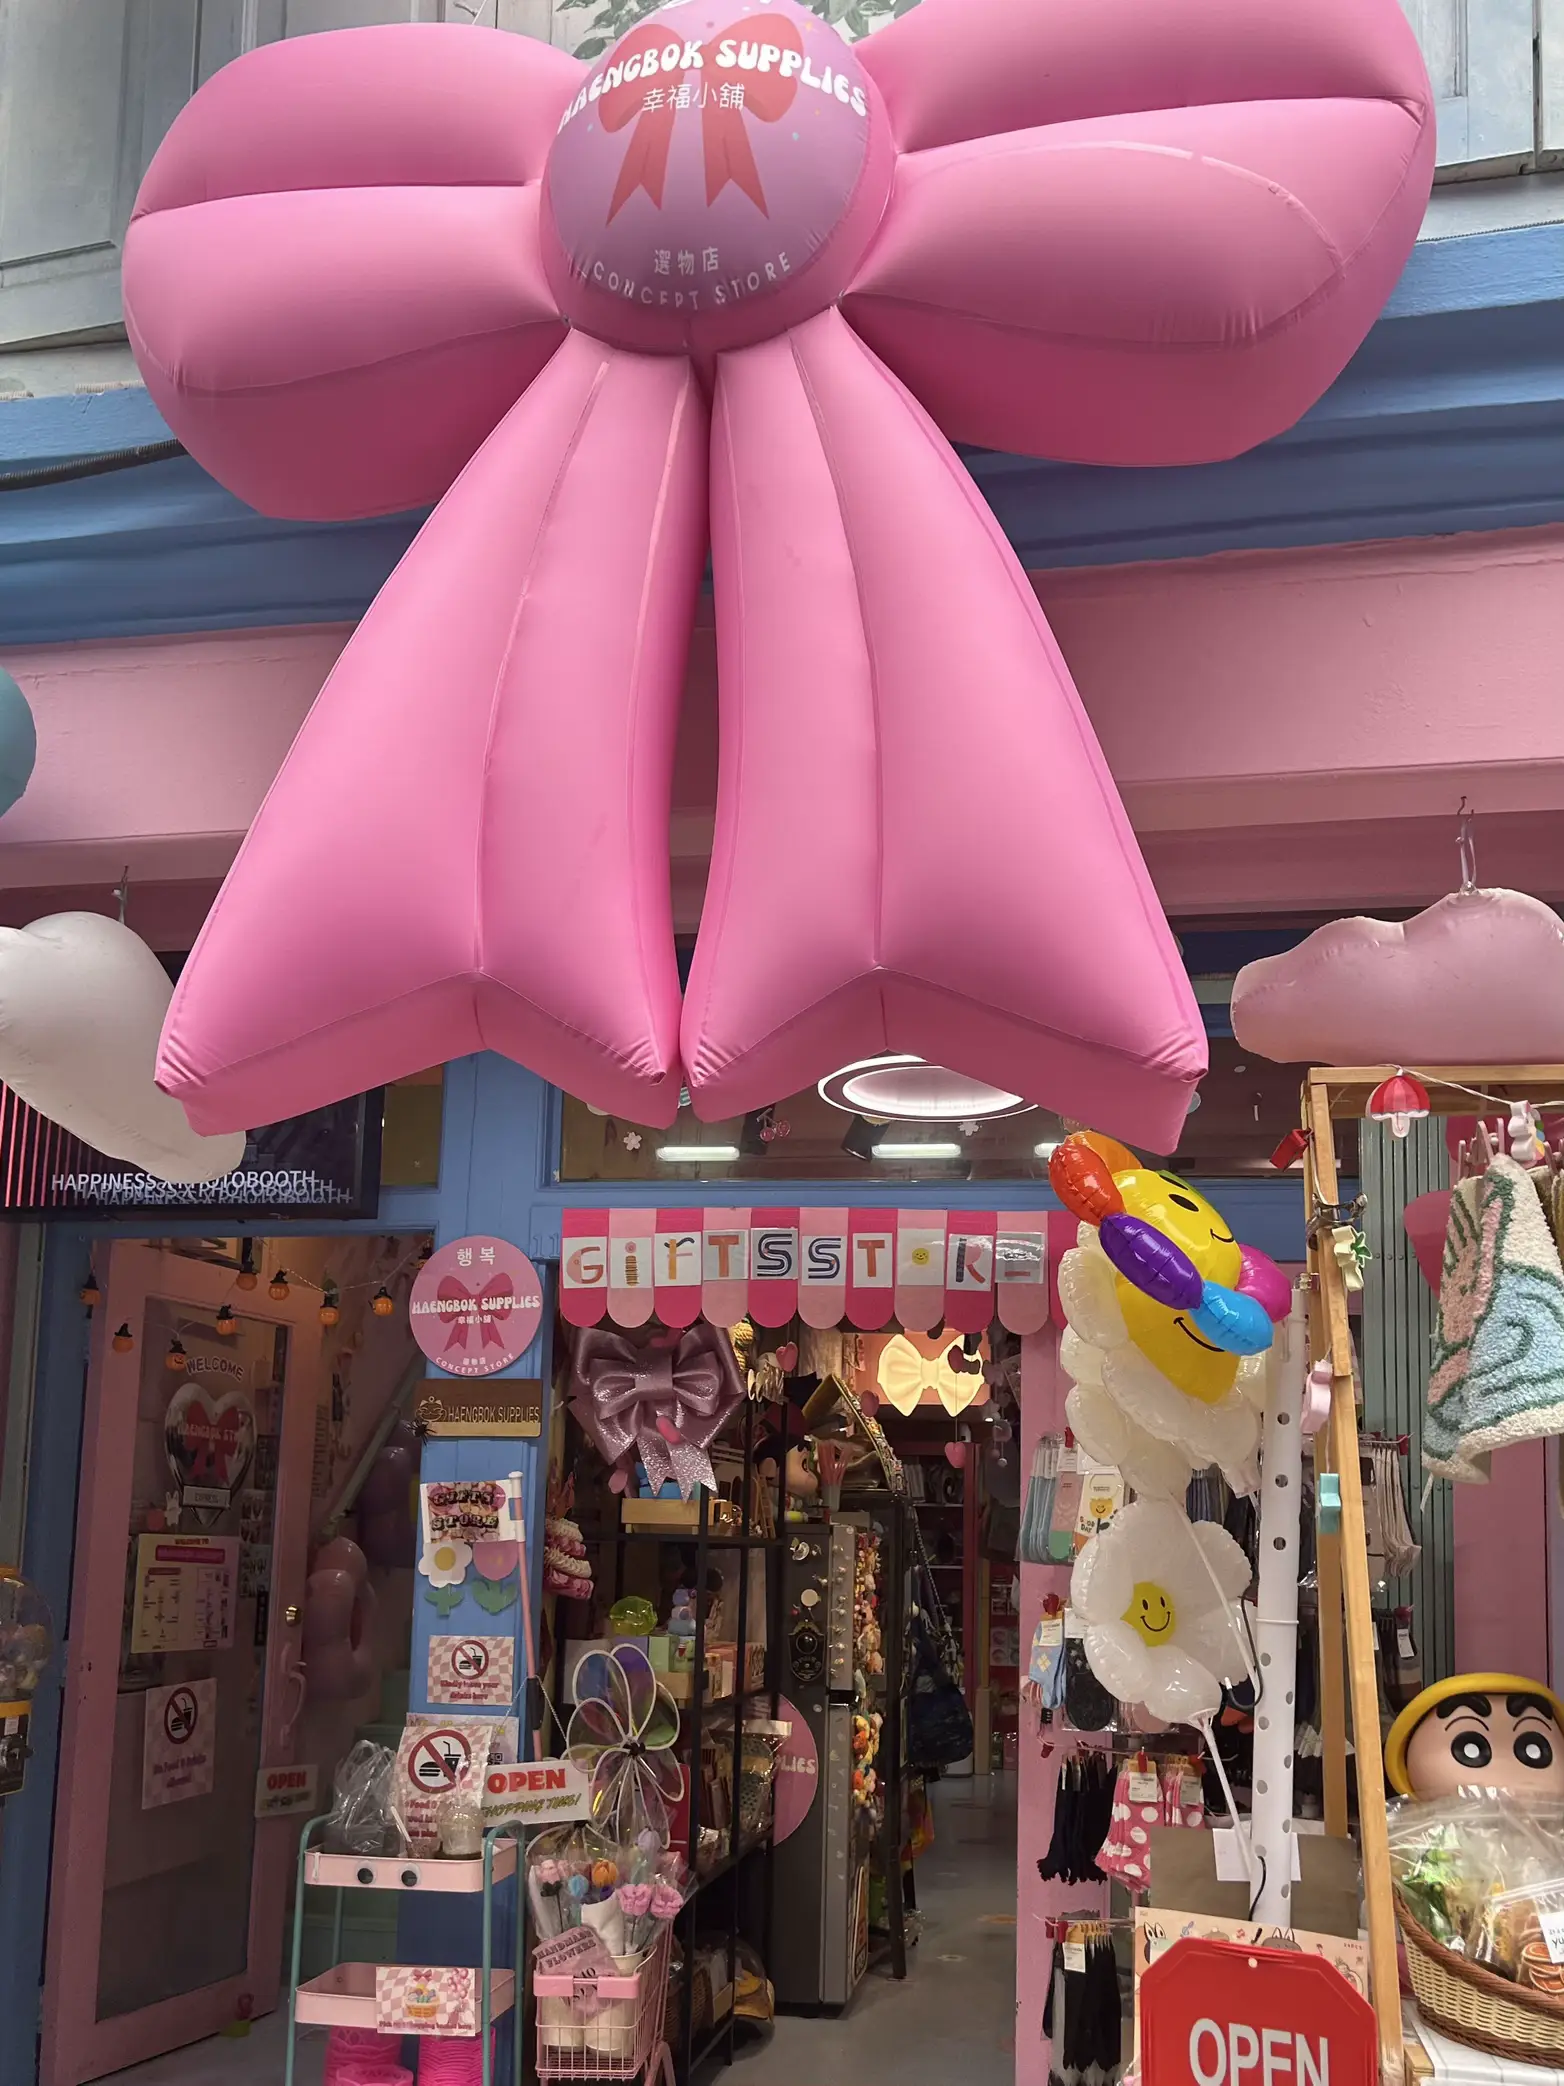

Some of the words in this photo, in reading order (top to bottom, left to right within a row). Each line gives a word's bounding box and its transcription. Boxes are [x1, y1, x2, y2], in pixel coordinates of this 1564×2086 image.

[715, 39, 867, 117] SUPPLIES
[641, 81, 745, 113] 幸福小舖
[653, 246, 720, 277] 選物店
[593, 260, 699, 310] CONCEPT
[714, 251, 791, 305] STORE
[52, 1172, 156, 1191] HAPPINESS
[411, 1298, 478, 1315] HAENGBOK
[481, 1296, 541, 1312] SUPPLIES
[186, 1356, 245, 1381] WELCOME
[435, 1356, 479, 1375] CONCEPT
[484, 1352, 515, 1373] STORE
[448, 1406, 496, 1423] HAENGBOK
[498, 1406, 540, 1423] SUPPLIES
[433, 1489, 494, 1506] GIFTS
[431, 1514, 499, 1531] STORE
[266, 1770, 307, 1791] OPEN
[487, 1768, 566, 1794] OPEN
[545, 1939, 597, 1968] FLOWERS
